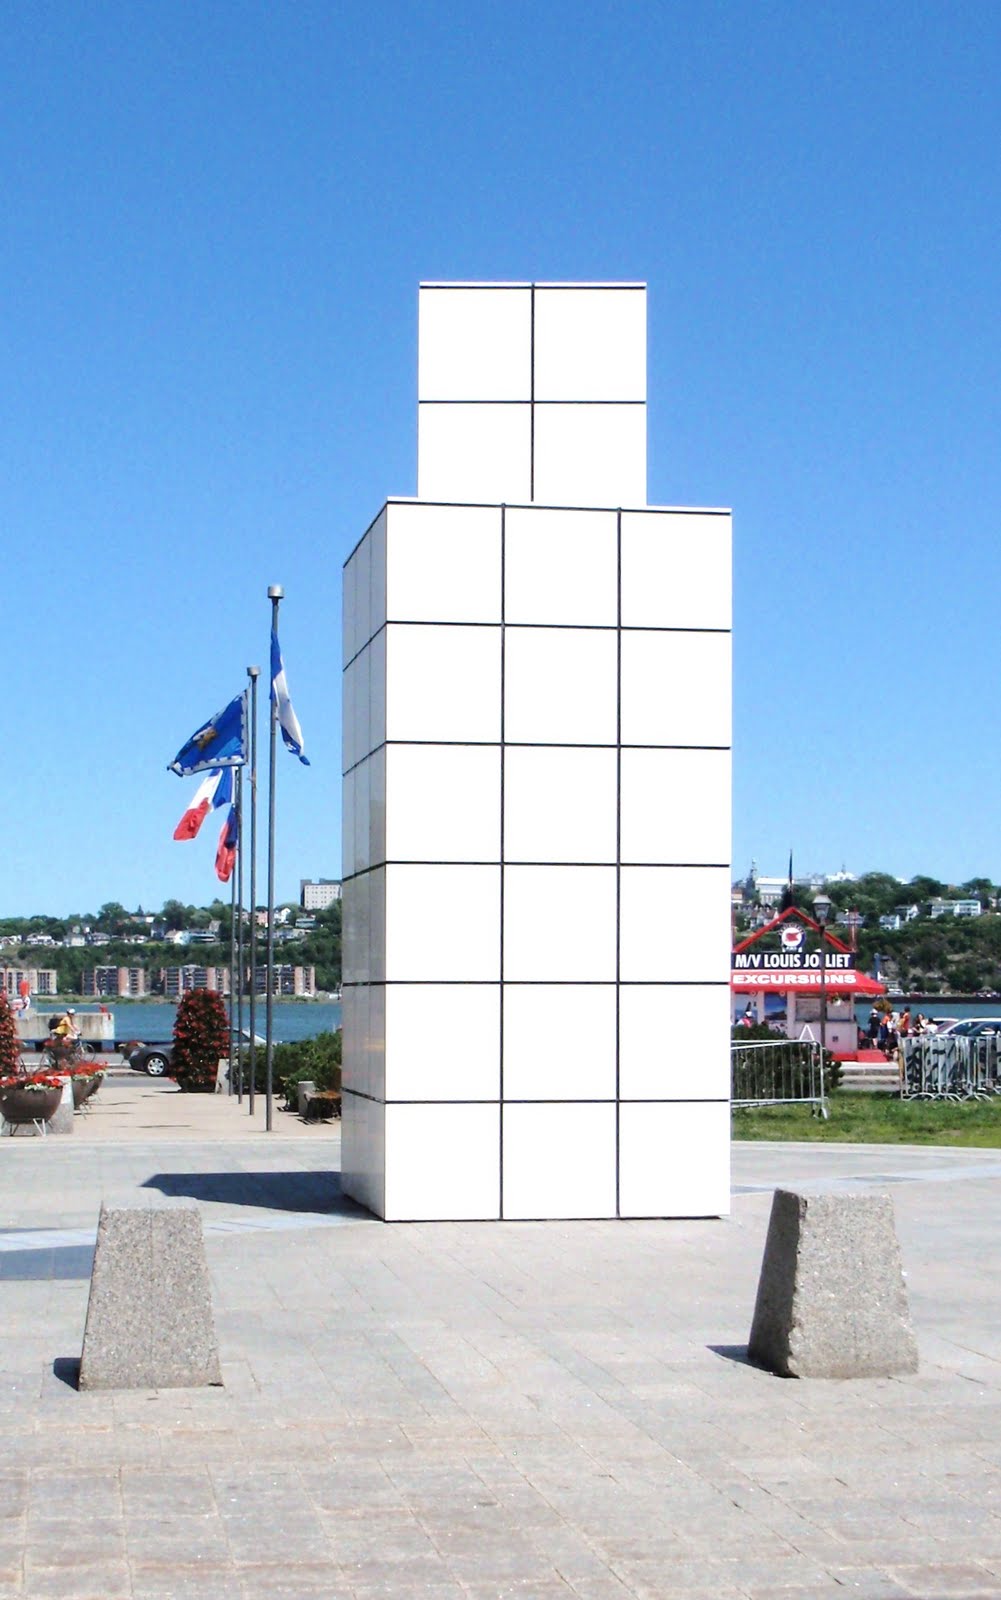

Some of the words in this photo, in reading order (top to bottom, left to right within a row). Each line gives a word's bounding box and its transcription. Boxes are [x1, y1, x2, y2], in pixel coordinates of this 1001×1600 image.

[735, 954, 761, 968] M/V
[764, 954, 801, 968] LOUIS
[803, 954, 851, 968] JOLIET
[733, 974, 857, 984] EXCURSIONS
